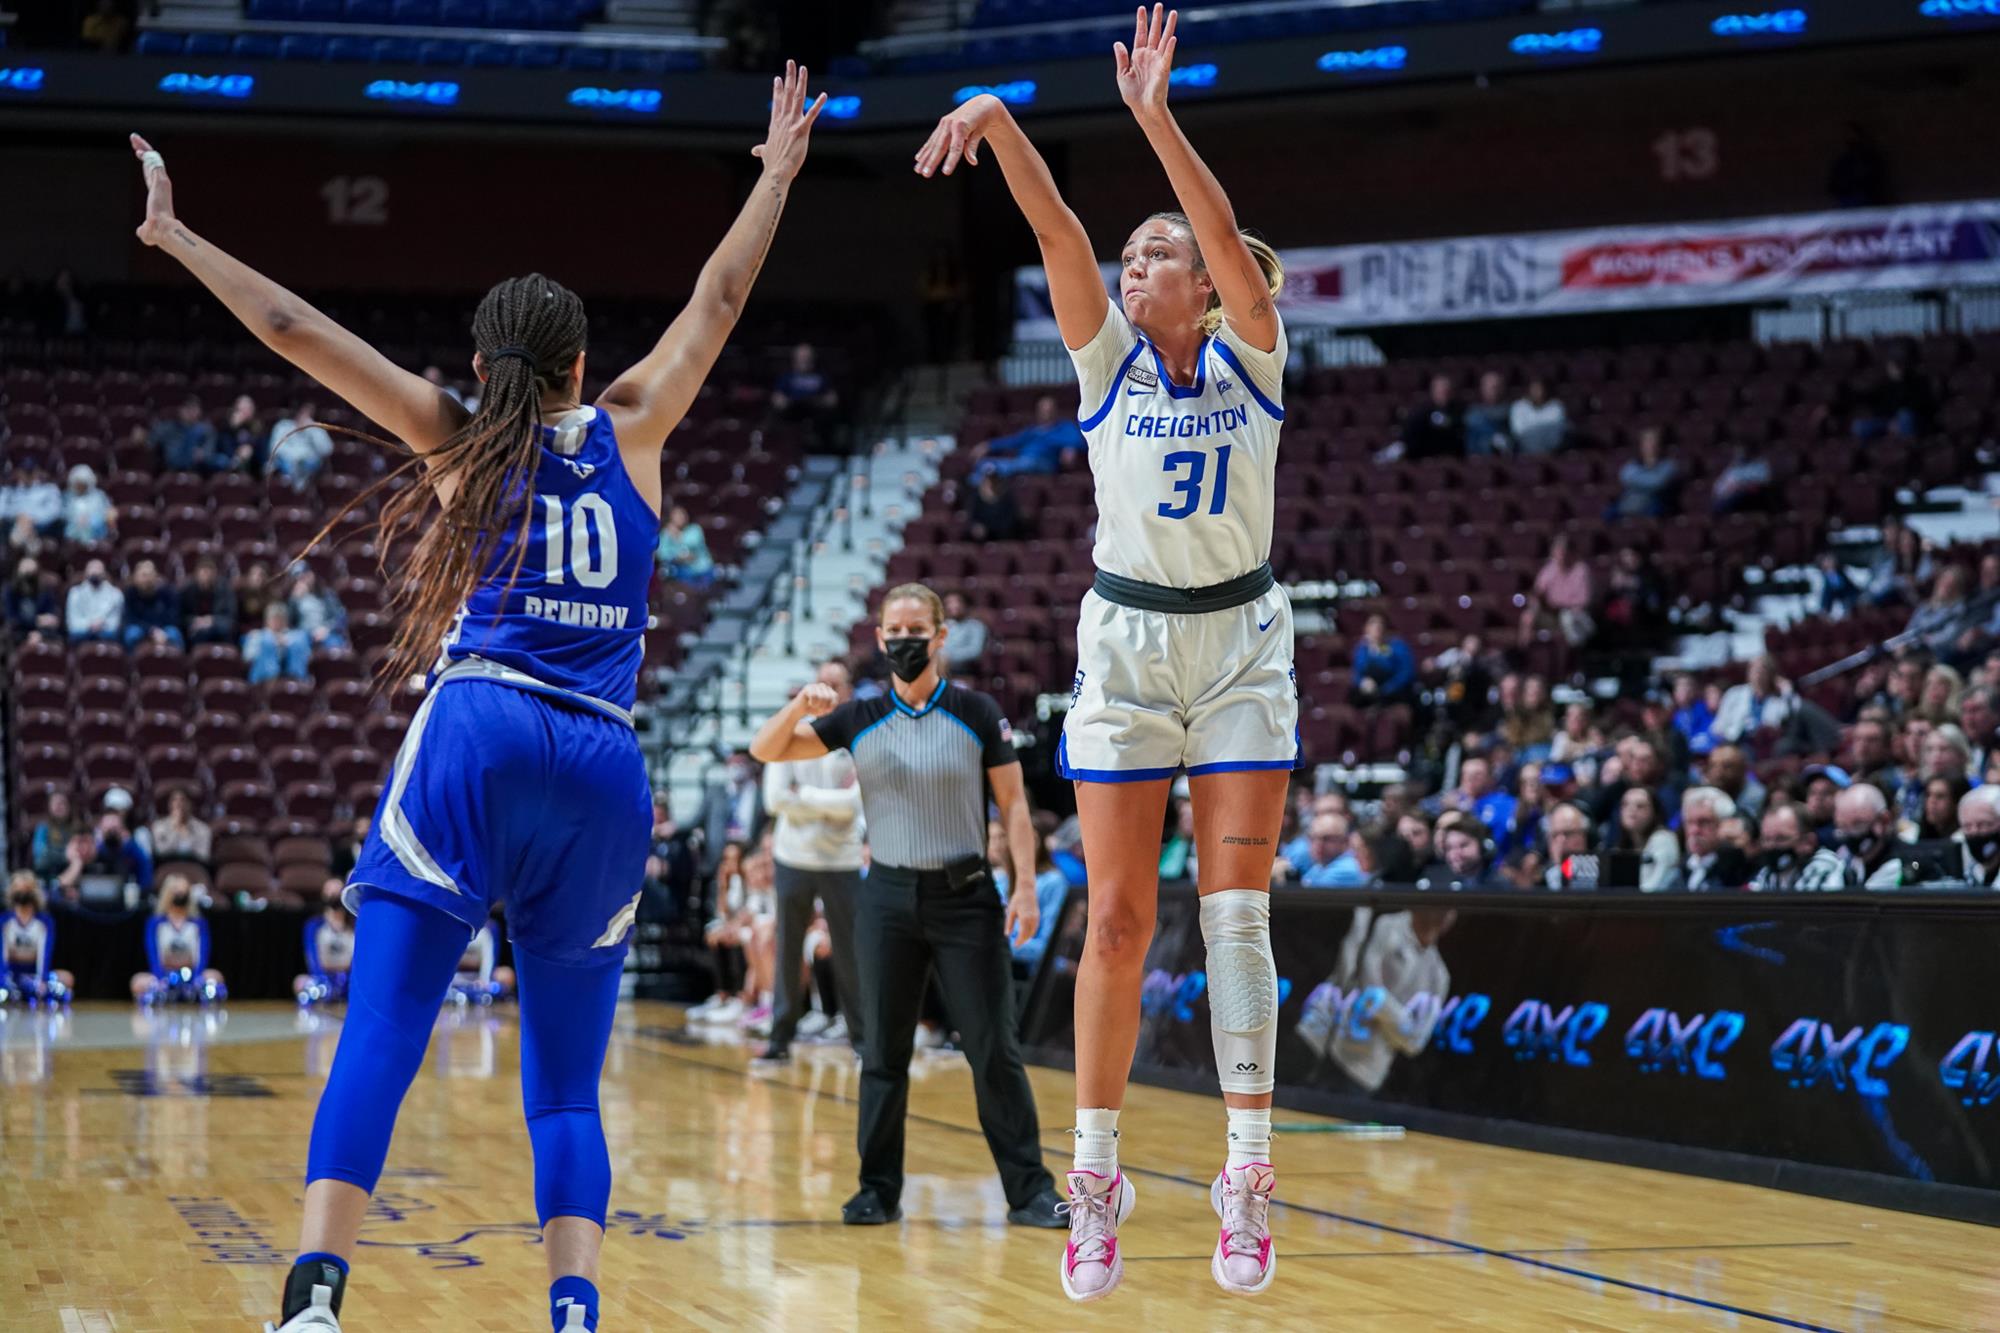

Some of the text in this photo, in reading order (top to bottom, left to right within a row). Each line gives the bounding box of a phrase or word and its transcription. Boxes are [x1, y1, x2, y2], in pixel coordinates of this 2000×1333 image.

[1652, 127, 1718, 179] 13
[322, 176, 388, 223] 12
[1125, 404, 1248, 438] CREIGHTON
[1157, 444, 1232, 520] 31
[541, 492, 618, 589] 10
